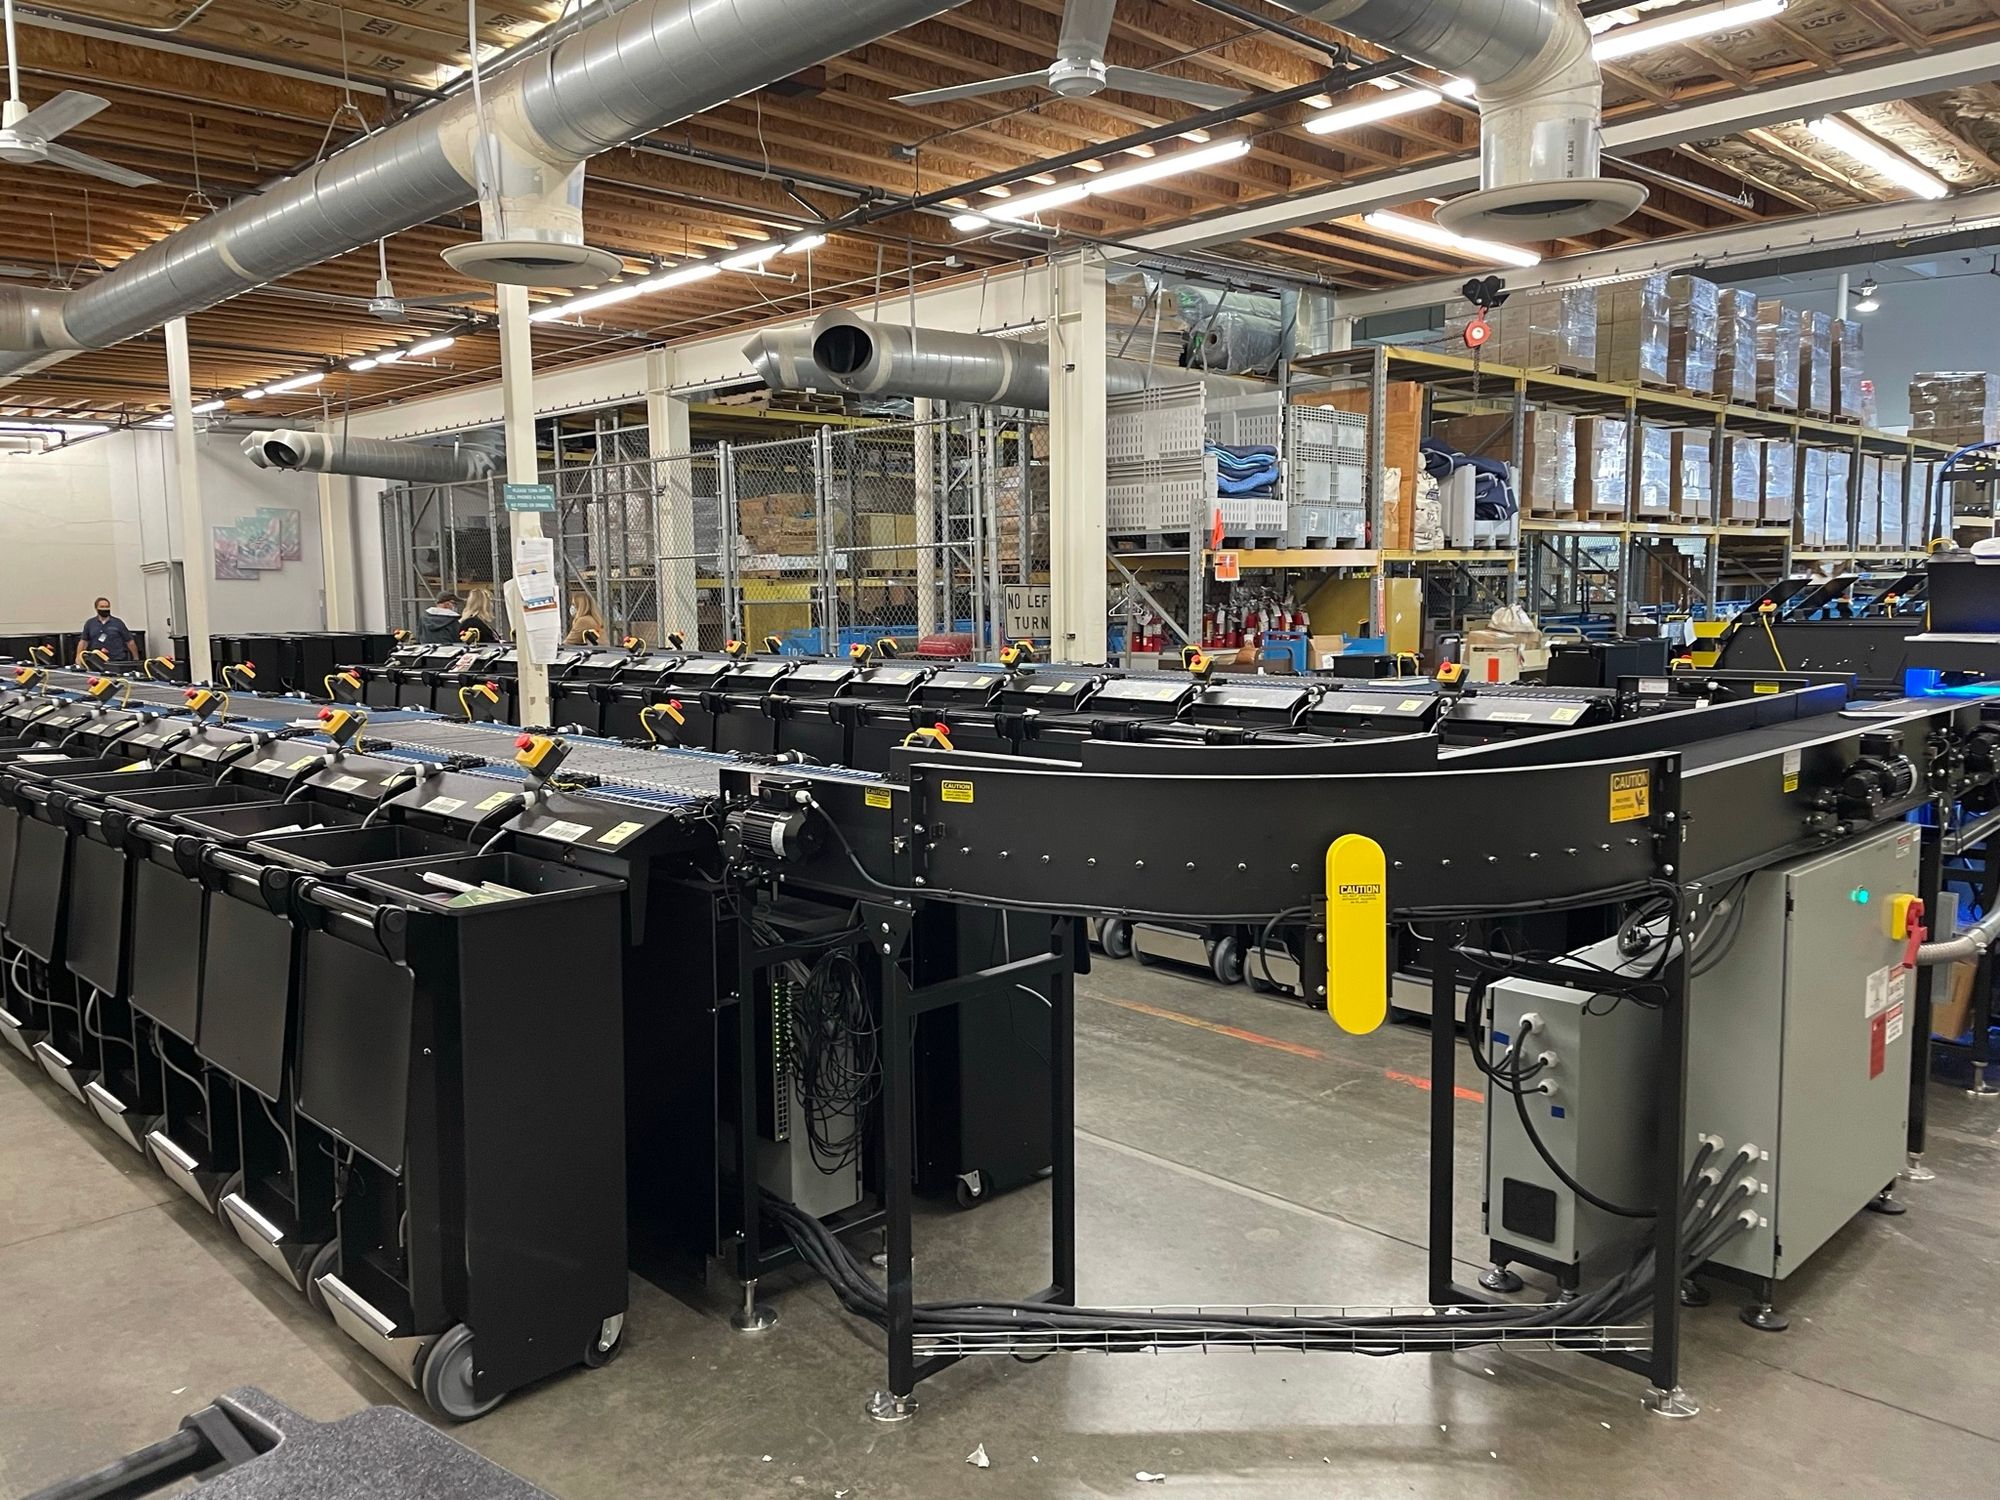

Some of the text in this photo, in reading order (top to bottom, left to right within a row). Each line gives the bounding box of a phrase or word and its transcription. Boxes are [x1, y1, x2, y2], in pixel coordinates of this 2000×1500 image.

[1008, 593, 1021, 610] NO
[1014, 616, 1049, 630] TURN
[787, 647, 805, 657] 102
[1614, 773, 1648, 790] CAUTION
[1340, 885, 1379, 894] CAUTION
